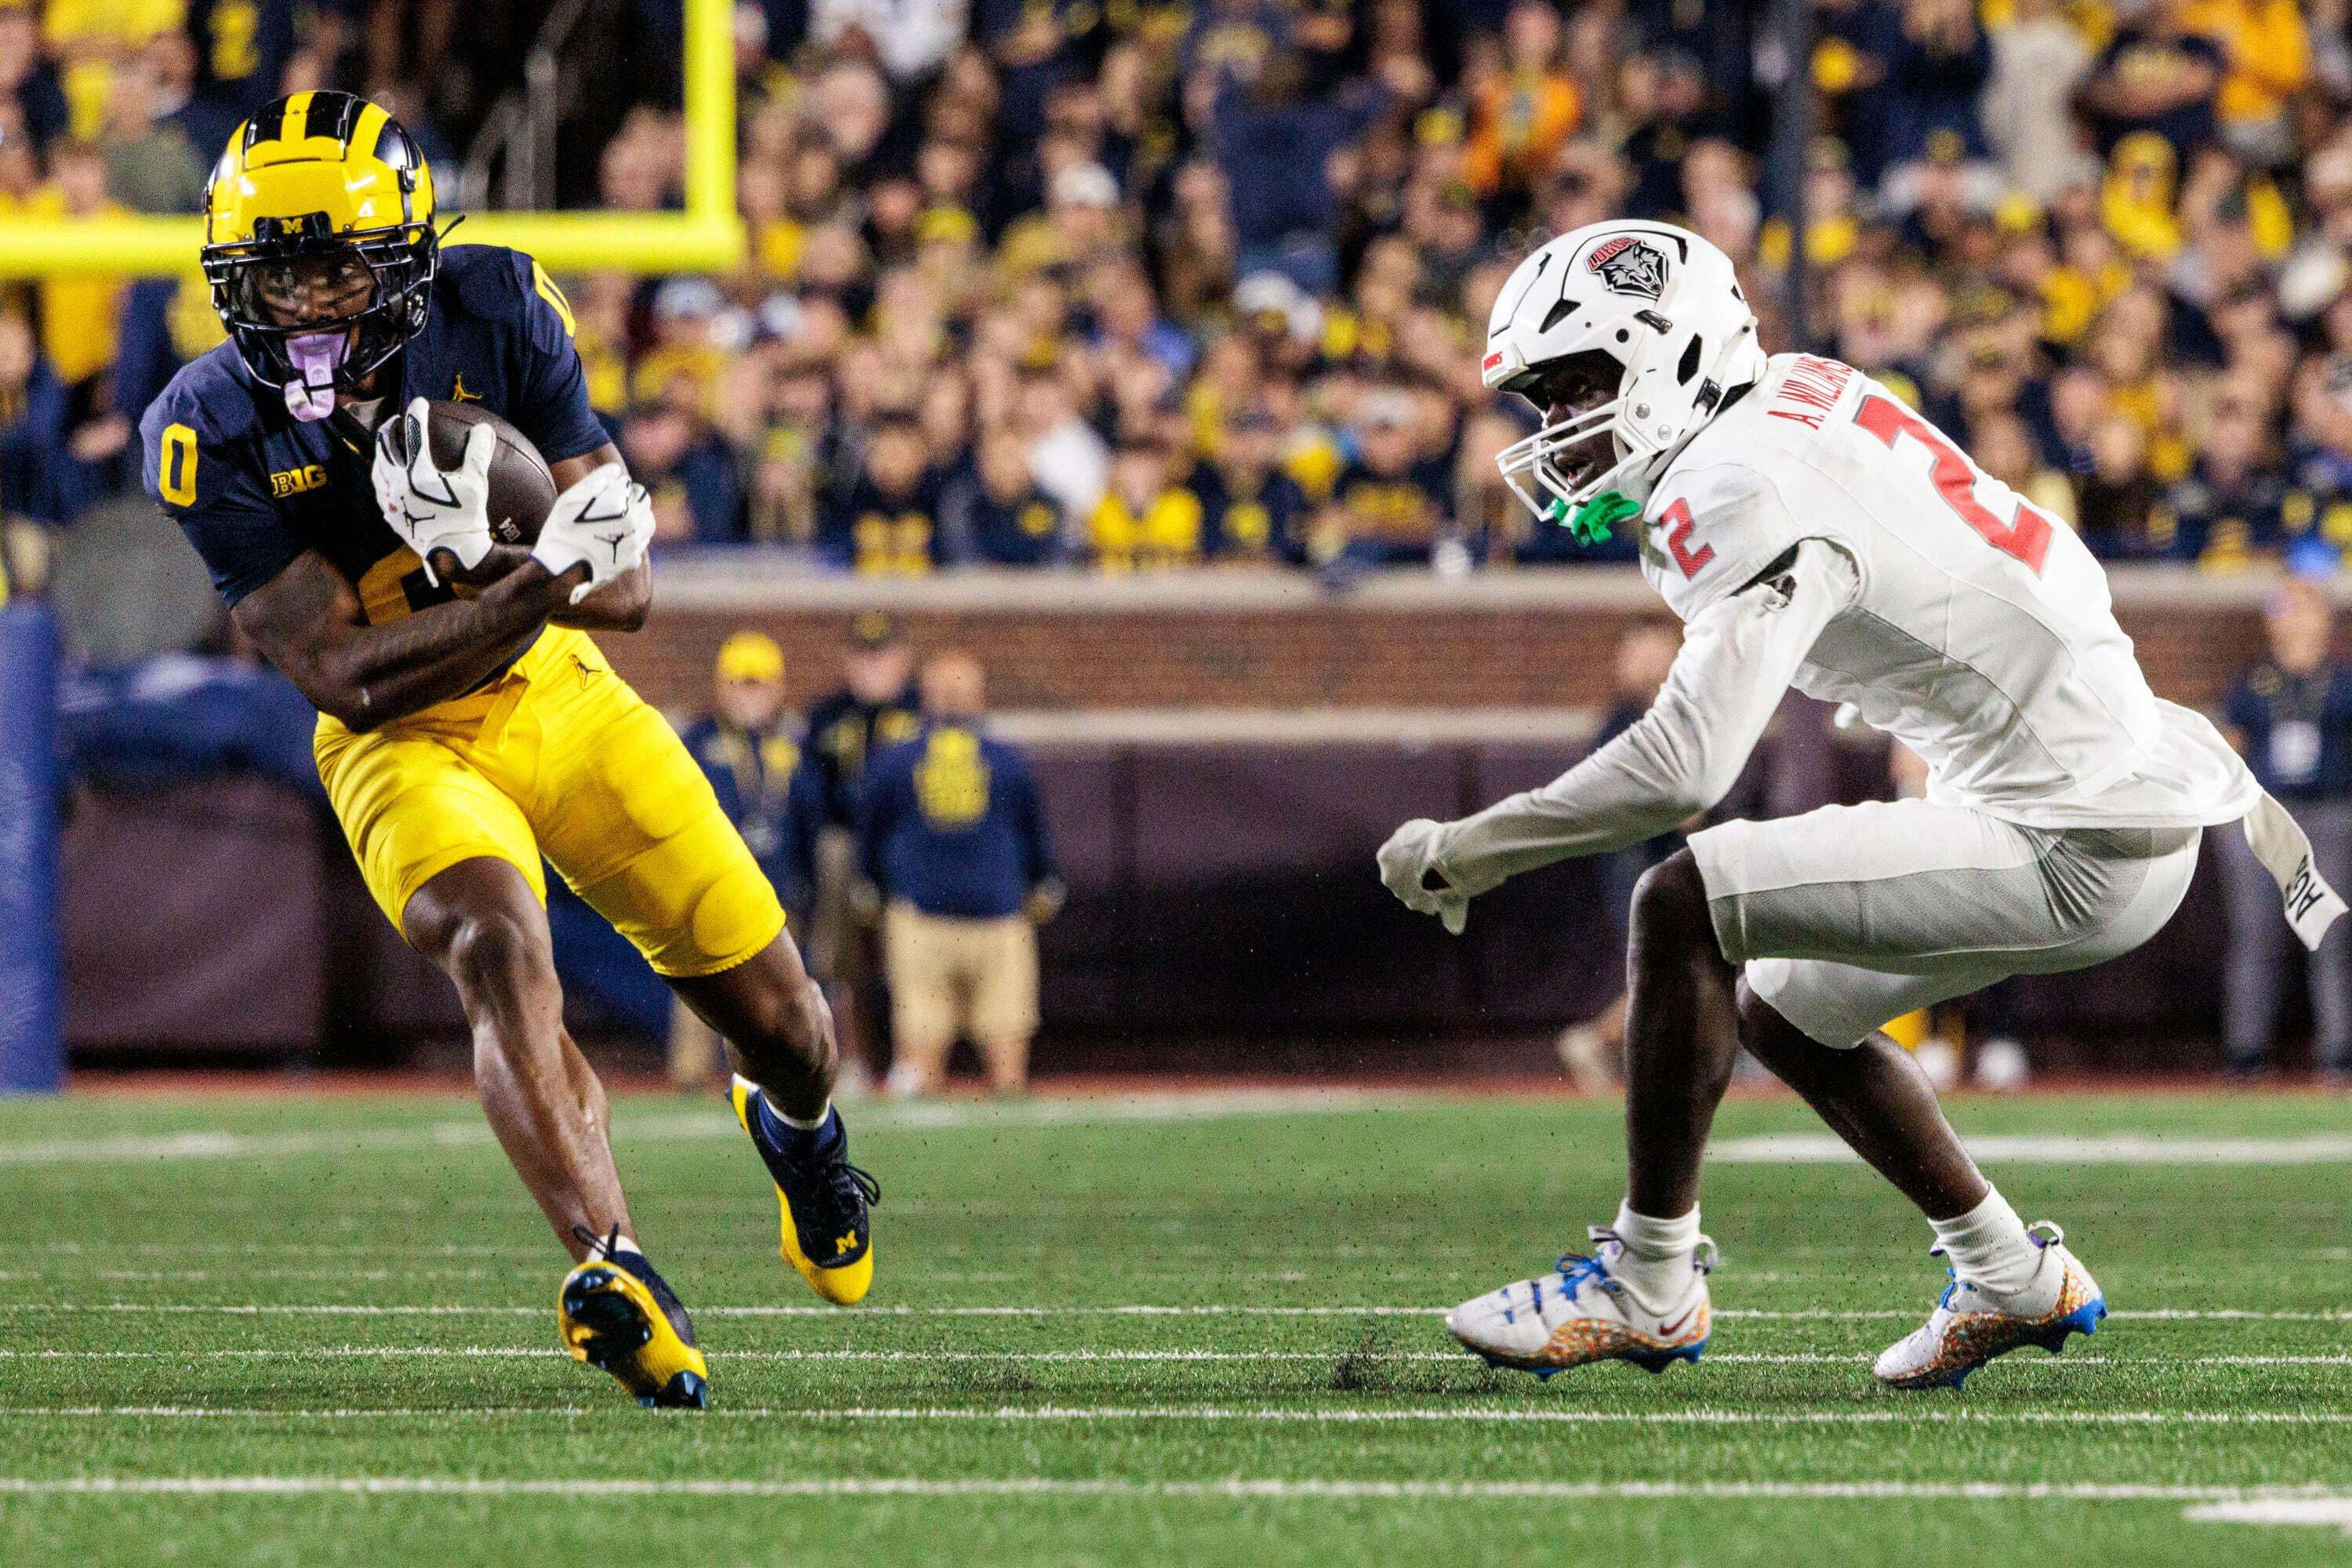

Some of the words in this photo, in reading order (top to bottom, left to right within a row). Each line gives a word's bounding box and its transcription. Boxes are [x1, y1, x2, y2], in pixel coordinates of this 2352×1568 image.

[281, 217, 303, 234] M
[158, 423, 198, 508] 0
[1852, 394, 2056, 582] 2
[1658, 497, 1717, 582] 2
[834, 1229, 859, 1255] M
